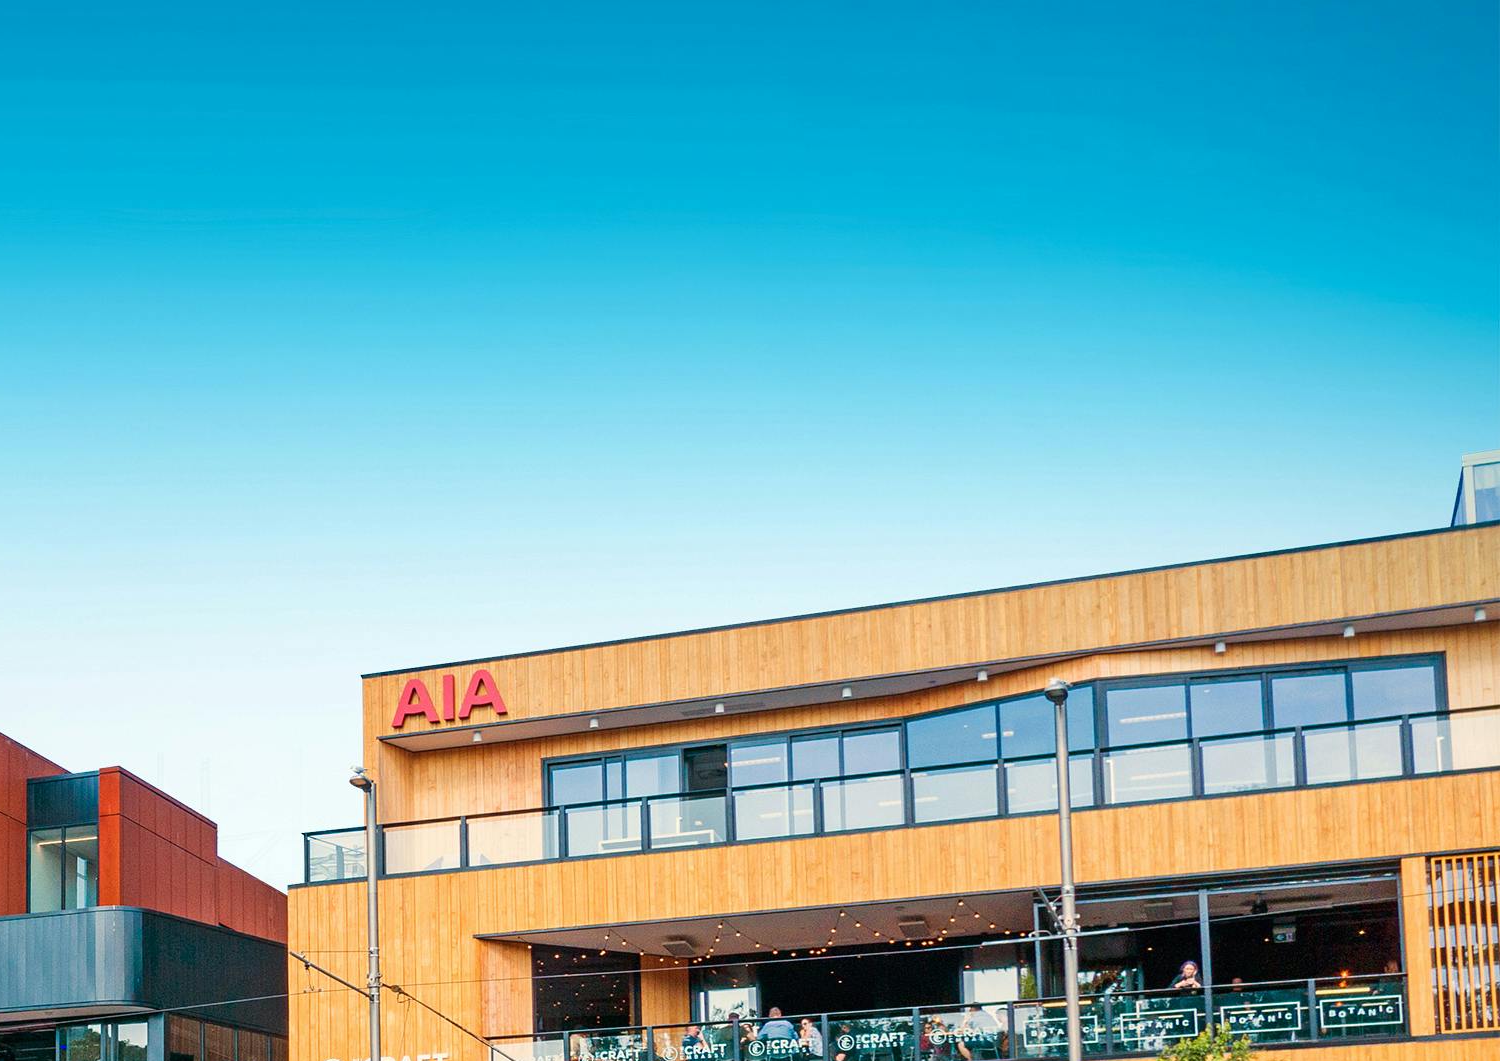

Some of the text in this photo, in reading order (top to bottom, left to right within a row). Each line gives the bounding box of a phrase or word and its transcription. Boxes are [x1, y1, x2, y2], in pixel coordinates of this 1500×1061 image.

[392, 669, 508, 728] AIA
[1328, 1005, 1395, 1018] BOTANIC
[1229, 1012, 1293, 1024] BOTANIC
[1128, 1018, 1190, 1031] BOTANIC
[861, 1032, 907, 1044] CRAFT
[1030, 1026, 1090, 1038] BOTAC
[685, 1043, 727, 1055] CRAFT
[771, 1038, 814, 1049] CRAFT
[601, 1049, 640, 1061] CRAFT
